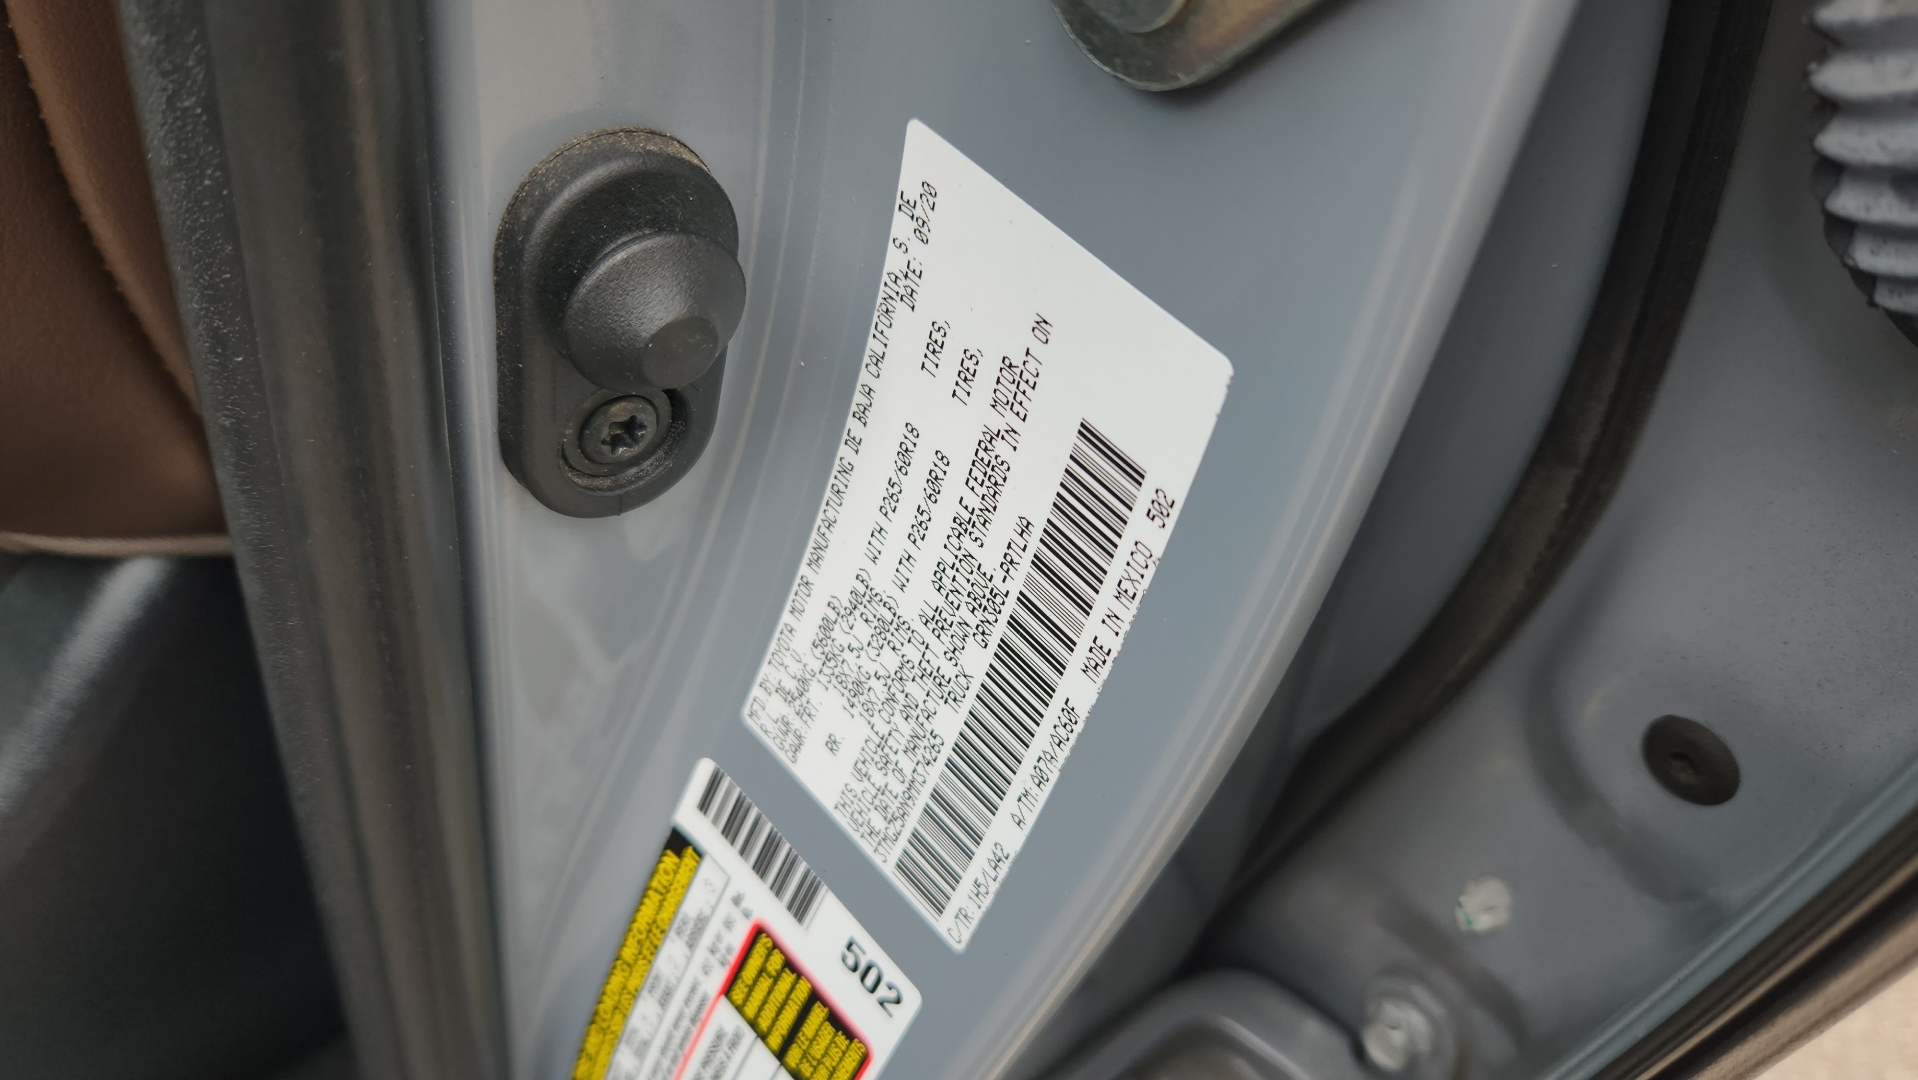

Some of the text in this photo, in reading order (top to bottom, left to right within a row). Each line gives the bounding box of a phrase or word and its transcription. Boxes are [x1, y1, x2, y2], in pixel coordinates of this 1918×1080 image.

[896, 189, 918, 221] DE
[891, 235, 910, 254] S.
[864, 267, 904, 379] CALIFORNIA,
[851, 381, 877, 427] BAJA
[774, 680, 791, 702] DE
[911, 179, 939, 245] 09/20
[842, 426, 864, 455] DE
[806, 454, 855, 574] MANUFACTURING
[815, 636, 846, 691] 1335KG
[836, 565, 872, 636] (2940LB)
[863, 522, 889, 565] WITH
[877, 420, 922, 522] P265/60R18
[918, 319, 951, 377] TIRES,
[1144, 485, 1176, 531] 502
[824, 347, 983, 757] RR. 1490KG (3280LB) WITH P265/60R18 TIRES,
[833, 354, 1020, 818] THIS VEHICLE CONFORMS TO ALL APPLICABLE FEDERAL MOTOR
[846, 312, 1053, 834] VEHICLE SAFETY AND THEFT PREVENTION STANDARDS IN EFFECT ON
[1111, 538, 1154, 611] MEXICO
[788, 573, 815, 621] MOTOR
[808, 593, 844, 661] (5600LB)
[859, 586, 886, 628] RIMS.
[943, 663, 975, 714] TRUCK
[970, 514, 1035, 650] GRN305L-PRTLHA
[1100, 608, 1125, 637] IN
[886, 613, 914, 657] RIMS.
[1079, 634, 1112, 684] MADE
[860, 562, 997, 848] THE DATE OF MANUFACTURE SHOWN ABOVE.
[841, 935, 904, 1018] 502
